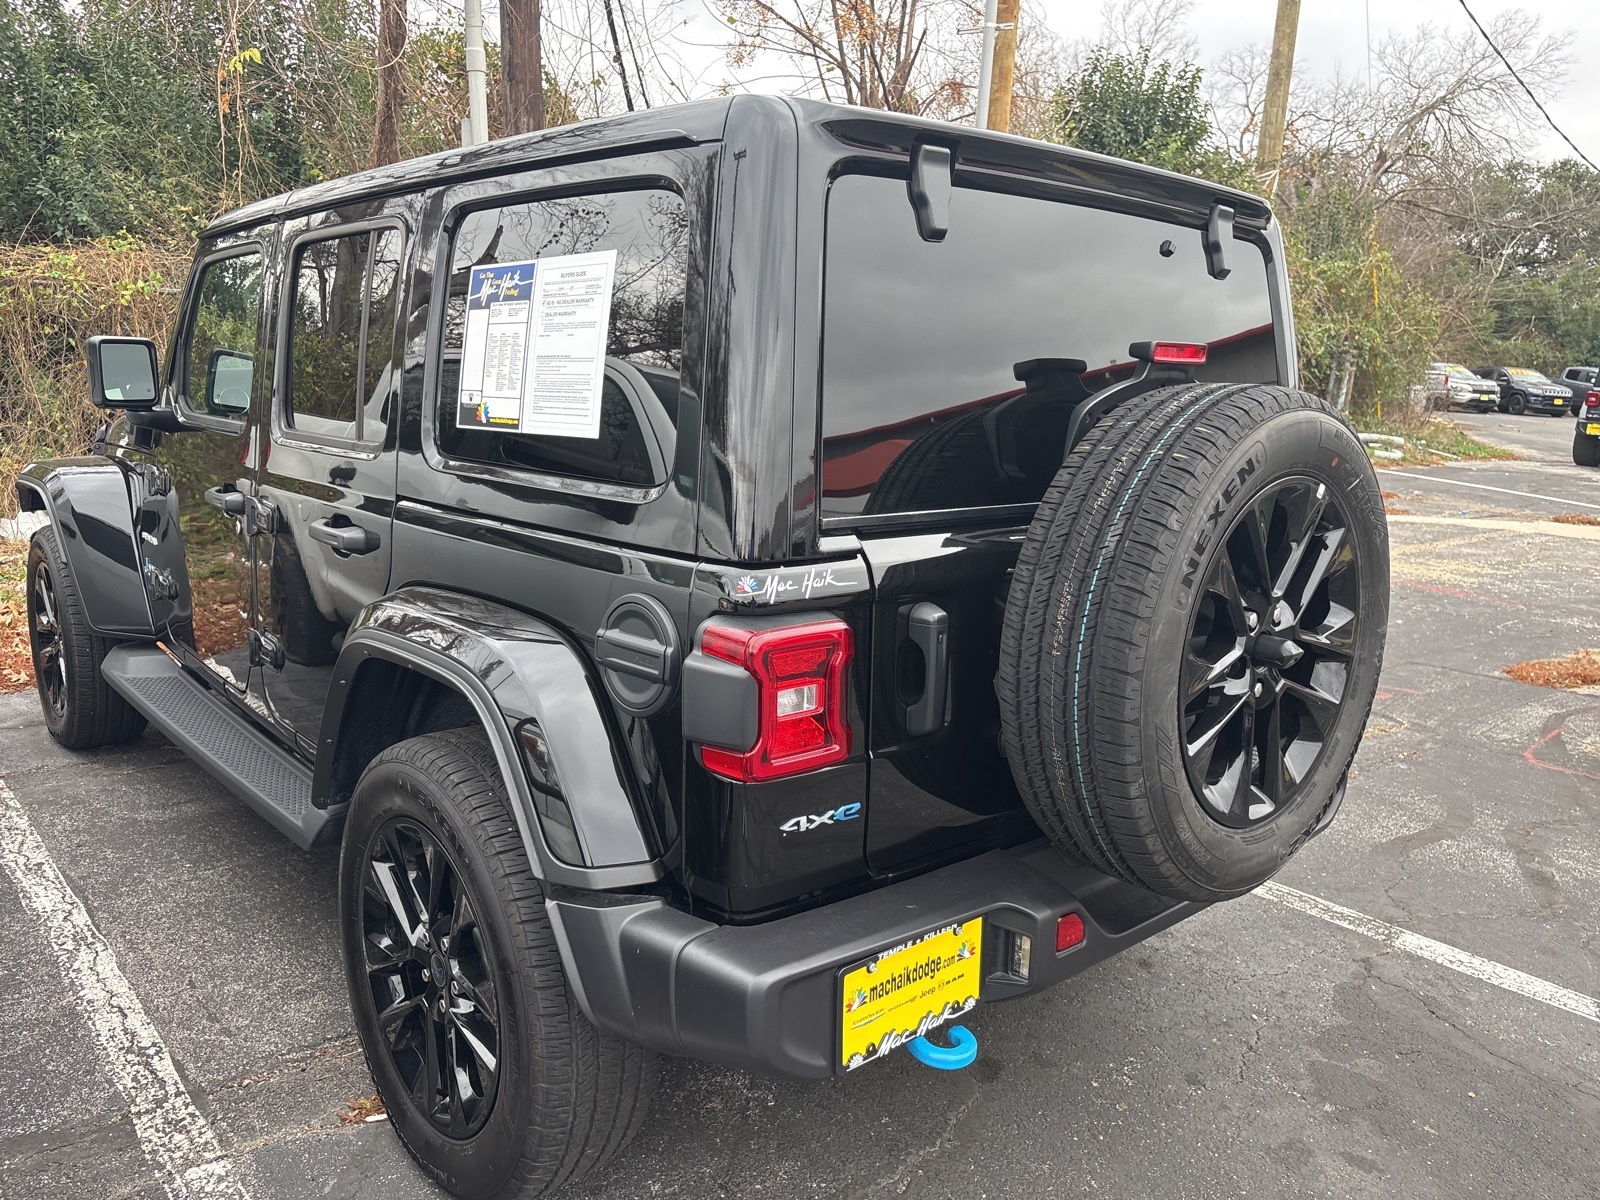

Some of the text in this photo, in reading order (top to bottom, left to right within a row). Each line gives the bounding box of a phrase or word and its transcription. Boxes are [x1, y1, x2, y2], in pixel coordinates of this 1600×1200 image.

[1181, 458, 1257, 588] NEXEN
[763, 567, 840, 604] Mac Haik
[878, 923, 958, 961] TEMPLE KILLEEN
[868, 954, 956, 1003] machaikdodge.com
[919, 986, 936, 999] Jeep
[945, 973, 965, 986] RAM
[877, 1003, 954, 1058] Mac Haik
